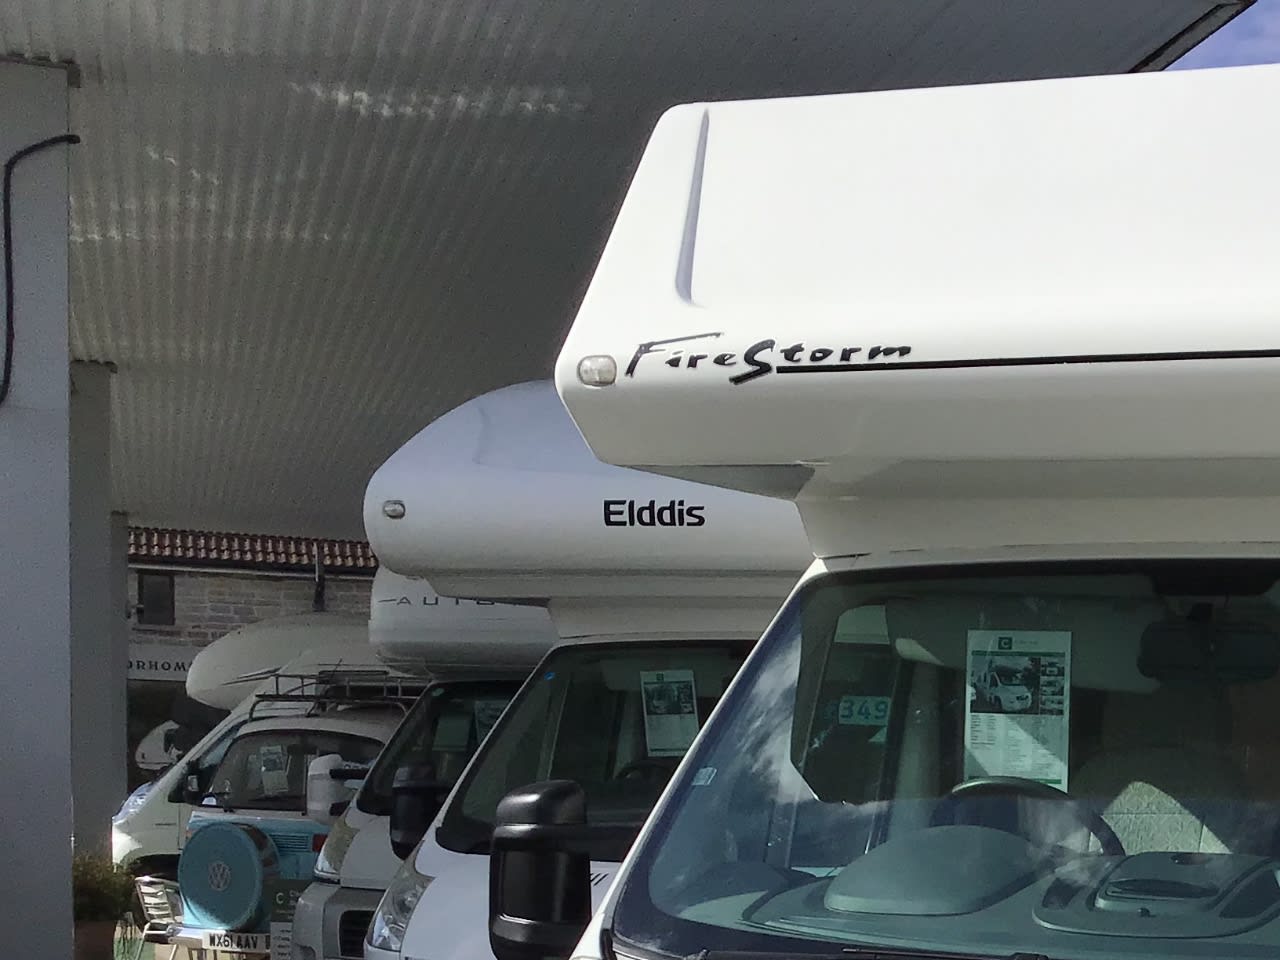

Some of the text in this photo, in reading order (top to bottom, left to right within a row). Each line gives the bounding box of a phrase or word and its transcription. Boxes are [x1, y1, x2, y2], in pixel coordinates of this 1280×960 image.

[624, 332, 912, 385] FireStorm
[603, 499, 706, 526] Elddis
[128, 660, 193, 671] RHOM
